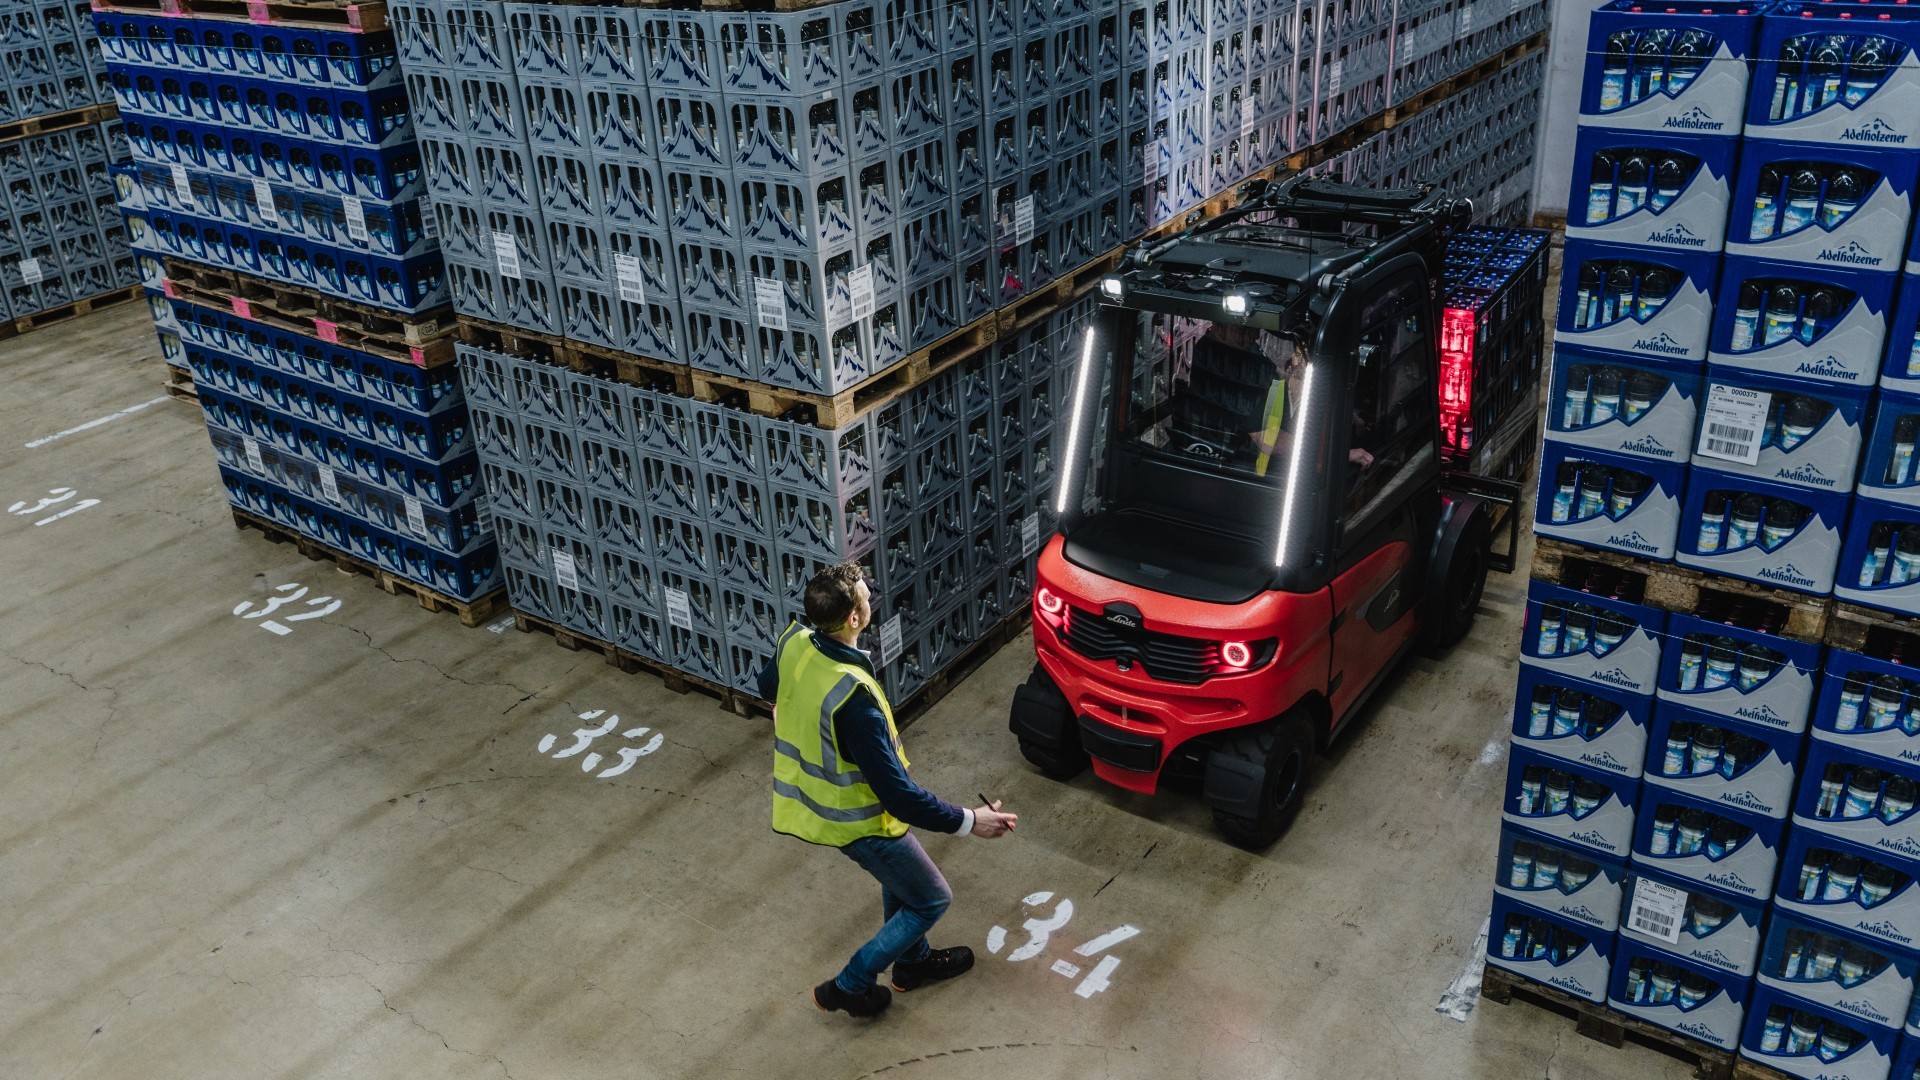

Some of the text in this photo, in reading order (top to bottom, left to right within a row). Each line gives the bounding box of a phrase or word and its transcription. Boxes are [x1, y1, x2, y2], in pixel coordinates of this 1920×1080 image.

[1662, 116, 1724, 131] Adelholzener
[1839, 128, 1908, 144] Adelholzener
[1647, 231, 1706, 247] Adelholzener
[1816, 249, 1882, 266] Adelholzener
[1632, 339, 1690, 356] Adelholzener
[1795, 362, 1859, 381] Adelholzener
[1731, 388, 1758, 398] 0000375
[1619, 440, 1674, 458] Adelholzener
[1775, 468, 1836, 487] Adelholzener
[7, 487, 102, 527] 31
[1606, 535, 1659, 554] Adelholzener
[1757, 567, 1816, 587] Adelholzener
[232, 583, 342, 636] 32
[1106, 614, 1136, 628] Linde
[1590, 670, 1641, 690] Adelholzener
[1734, 706, 1790, 728] Adelholzener
[538, 709, 664, 778] 33
[1579, 753, 1628, 773] Adelholzener
[1720, 791, 1773, 814] Adelholzener
[1568, 830, 1617, 852] Adelholzener
[1704, 872, 1756, 895] Adelholzener
[1557, 905, 1604, 926] Adelholzener
[1854, 920, 1912, 944] Adelholzener
[986, 891, 1141, 999] 34
[1689, 949, 1740, 971] Adelholzener
[1548, 976, 1593, 997] Adelholzener
[1834, 1000, 1890, 1023] Adelholzener
[1675, 1021, 1725, 1045] Adelholzener
